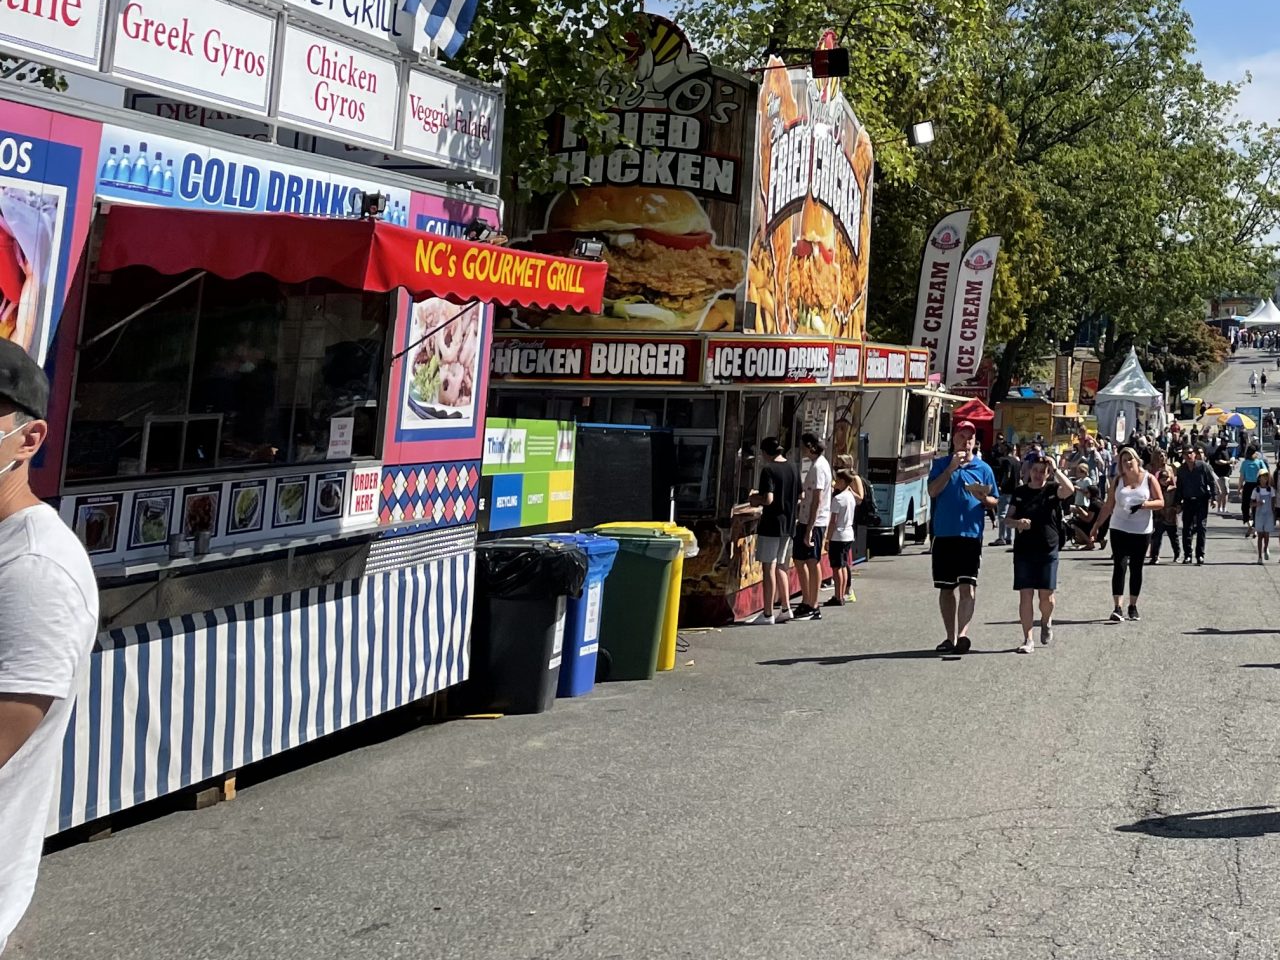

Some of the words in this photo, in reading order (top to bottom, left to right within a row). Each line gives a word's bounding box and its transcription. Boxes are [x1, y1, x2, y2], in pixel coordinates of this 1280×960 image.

[122, 3, 196, 56] Greek
[203, 29, 265, 77] Gyros
[307, 44, 377, 94] Chicken
[314, 81, 365, 123] Gyros
[409, 94, 449, 134] Veggie
[454, 110, 491, 142] Falafel
[0, 138, 32, 174] OS
[553, 149, 734, 195] HICKEN
[179, 152, 261, 210] COLD
[767, 126, 812, 224] FRIED
[811, 132, 862, 256] CHICKEN
[415, 239, 456, 277] NC's
[463, 247, 546, 288] GOURMET
[547, 259, 585, 293] GRILL
[923, 261, 950, 332] CREAM
[960, 280, 983, 341] CREAM
[491, 348, 582, 374] HICKEN
[590, 343, 685, 375] BURGER
[714, 347, 742, 377] ICE
[745, 347, 786, 377] COLD
[788, 347, 828, 368] DRINKS
[956, 345, 975, 375] ICE
[488, 437, 505, 454] Think
[354, 473, 378, 491] ORDER
[355, 494, 374, 512] HERE
[496, 496, 518, 508] RECYCLING
